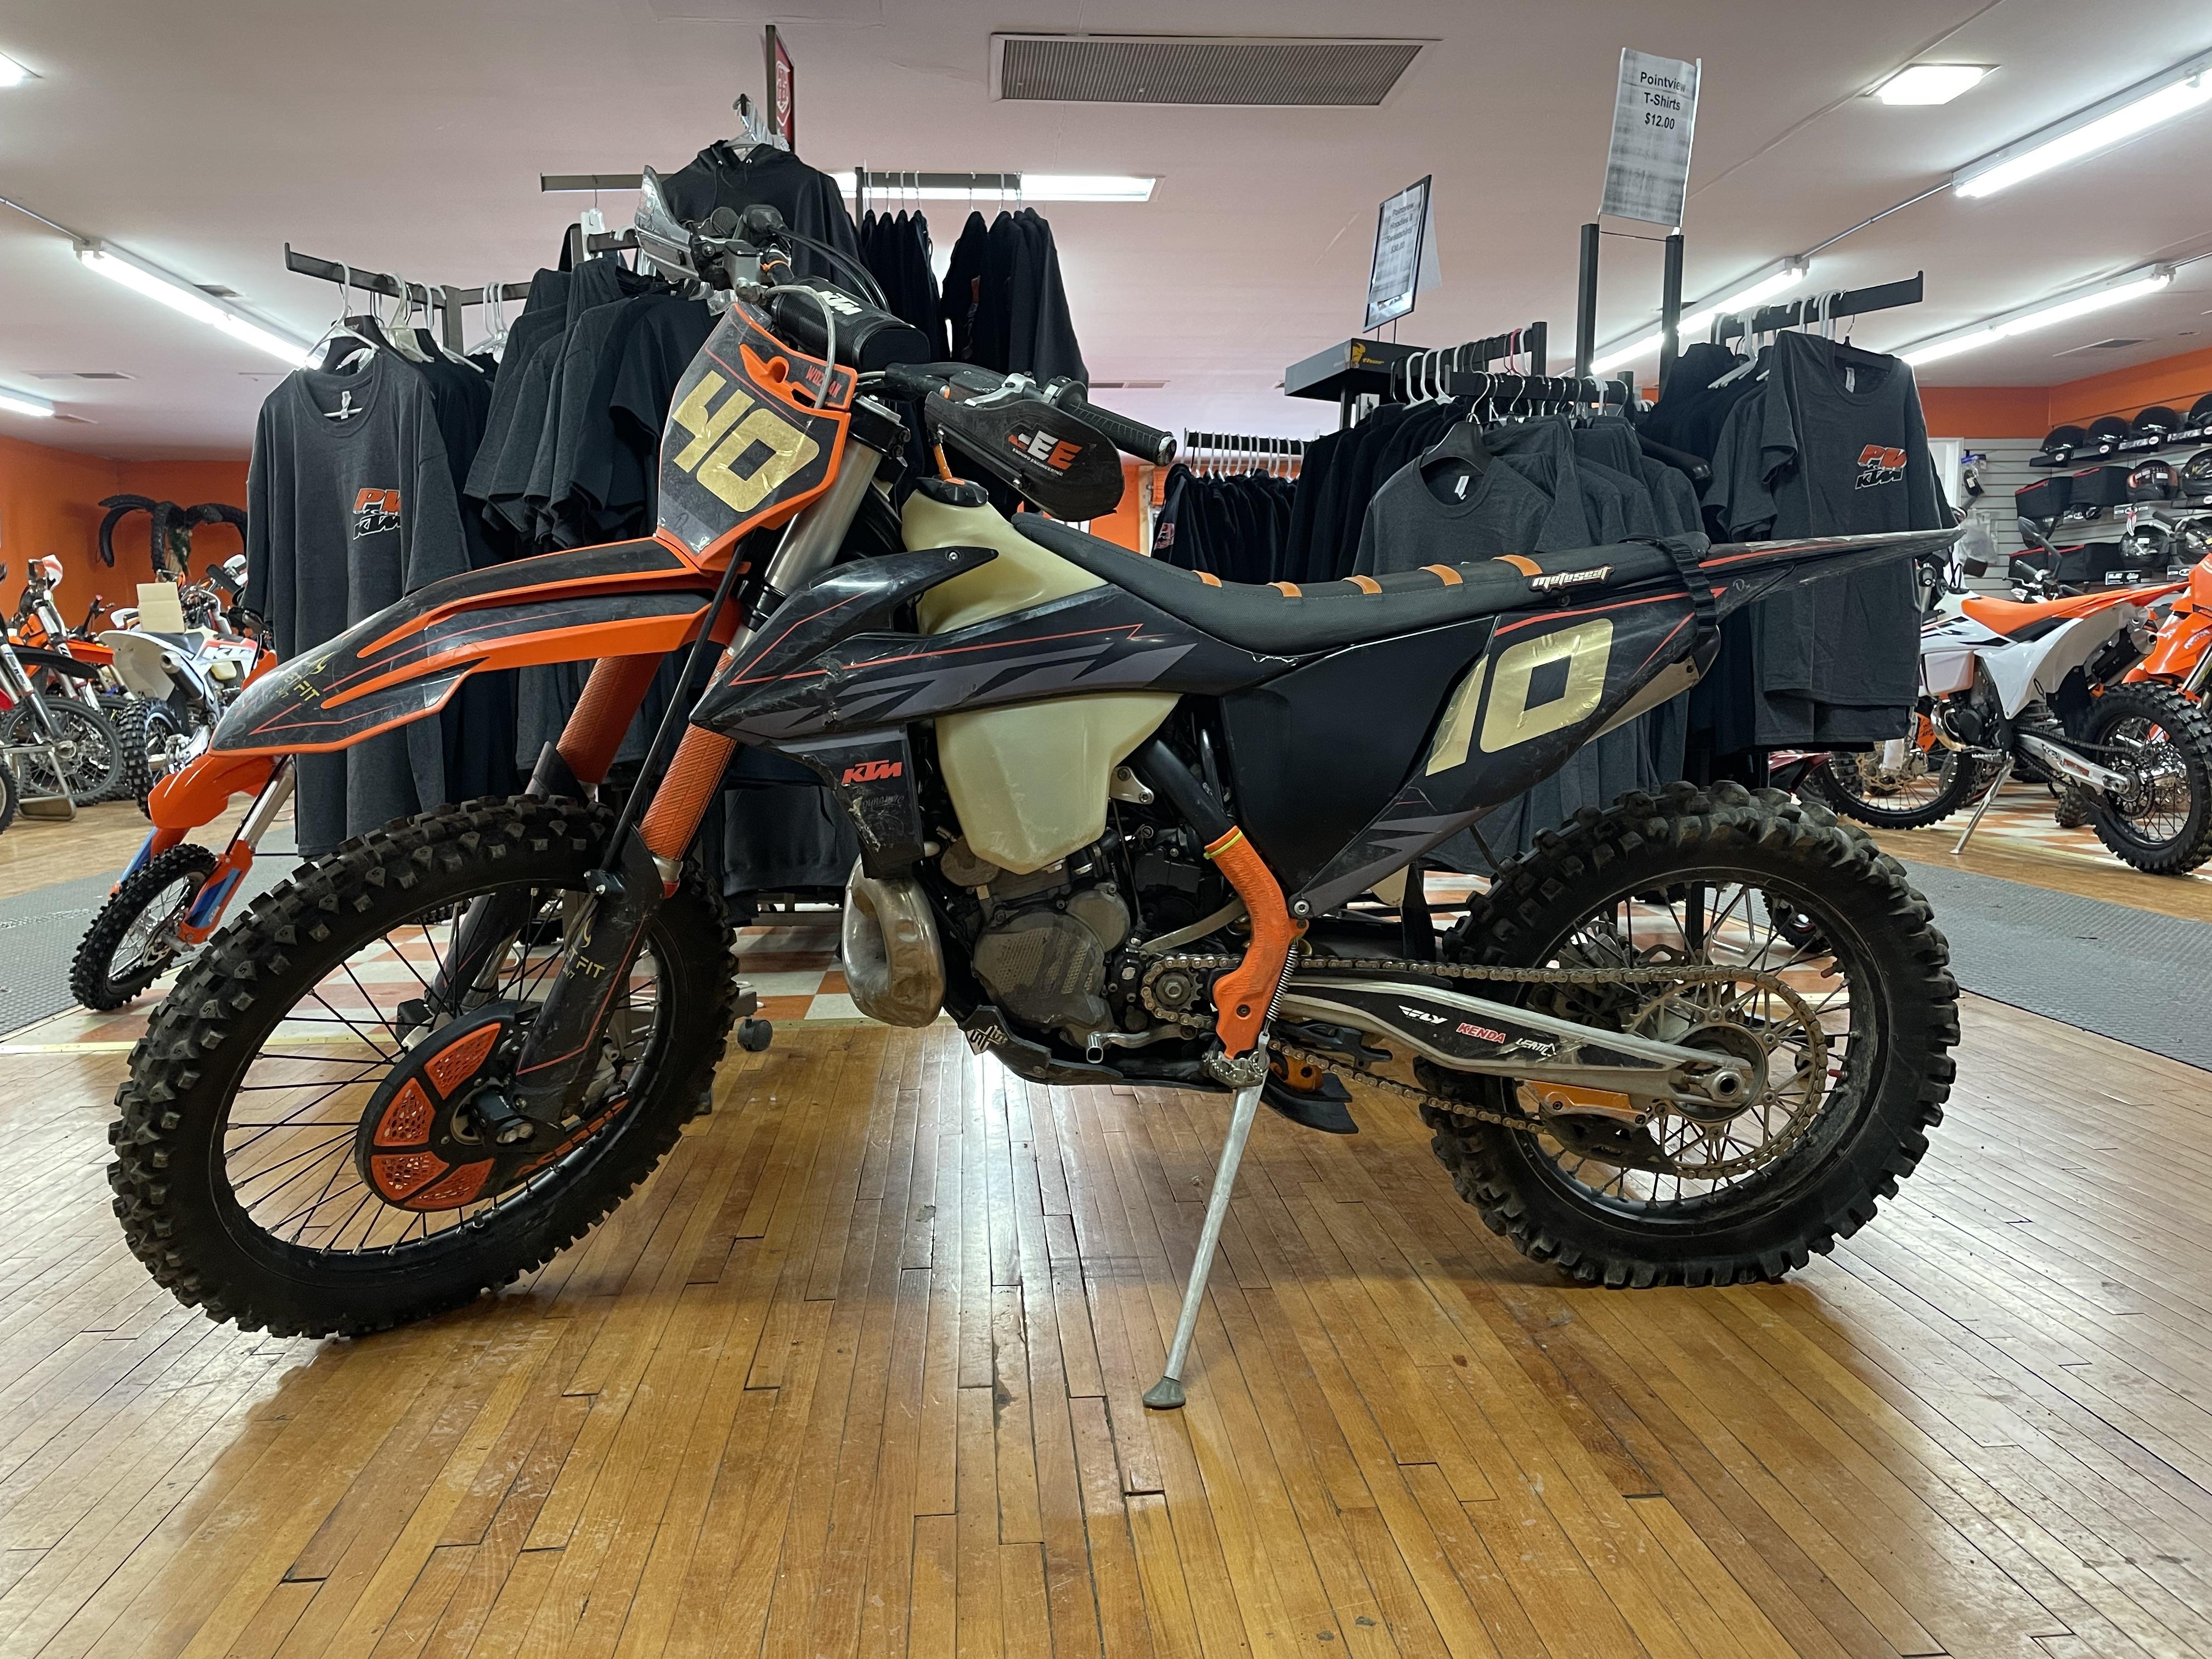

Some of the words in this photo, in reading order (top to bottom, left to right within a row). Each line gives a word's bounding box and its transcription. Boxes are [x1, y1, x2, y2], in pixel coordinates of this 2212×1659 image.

[1640, 71, 1686, 93] Pointview
[1644, 92, 1681, 111] T-Shirts
[1644, 112, 1675, 129] $12.00
[672, 370, 820, 512] 40
[1854, 467, 1904, 490] KTM
[293, 680, 320, 701] FIT
[841, 759, 902, 785] KTM
[576, 956, 605, 978] FIT
[1398, 1005, 1448, 1024] FLY
[1455, 1022, 1506, 1044] KENDA
